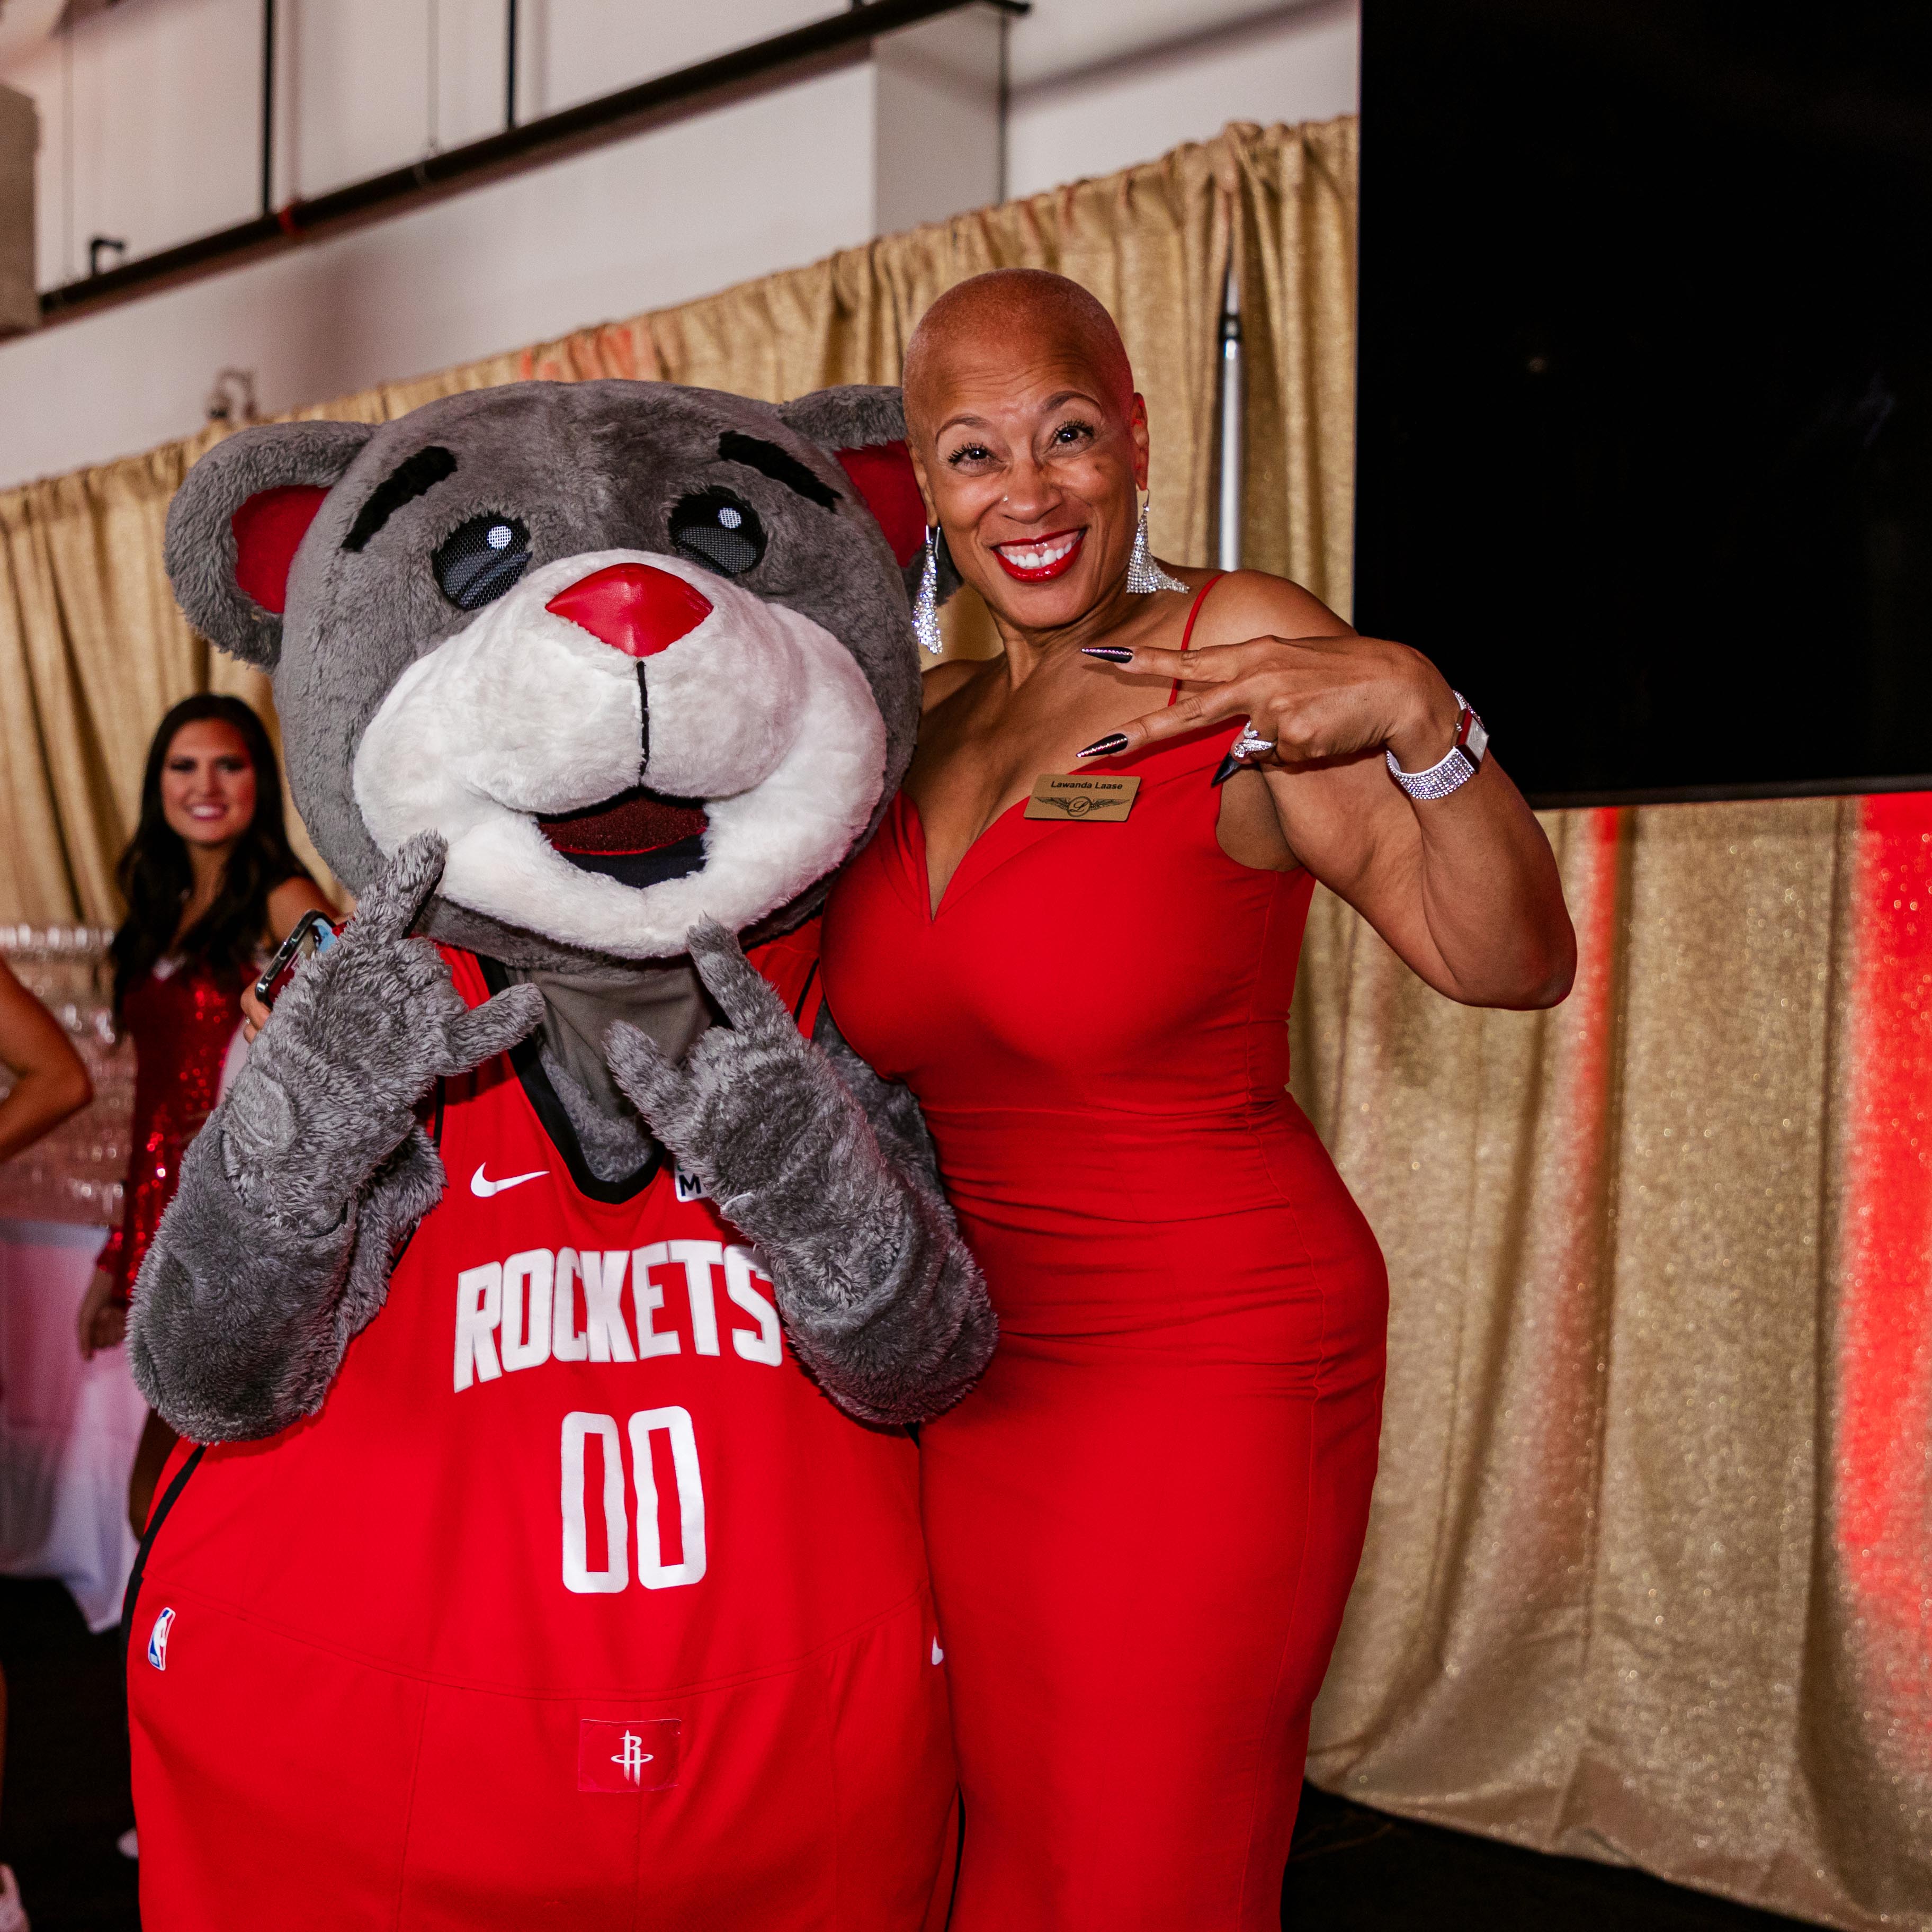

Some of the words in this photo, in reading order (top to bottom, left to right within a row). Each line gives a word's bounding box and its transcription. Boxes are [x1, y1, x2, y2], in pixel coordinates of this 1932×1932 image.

[1050, 780, 1092, 789] Lawanda
[454, 1240, 783, 1393] ROCKETS
[560, 1406, 706, 1594] 00
